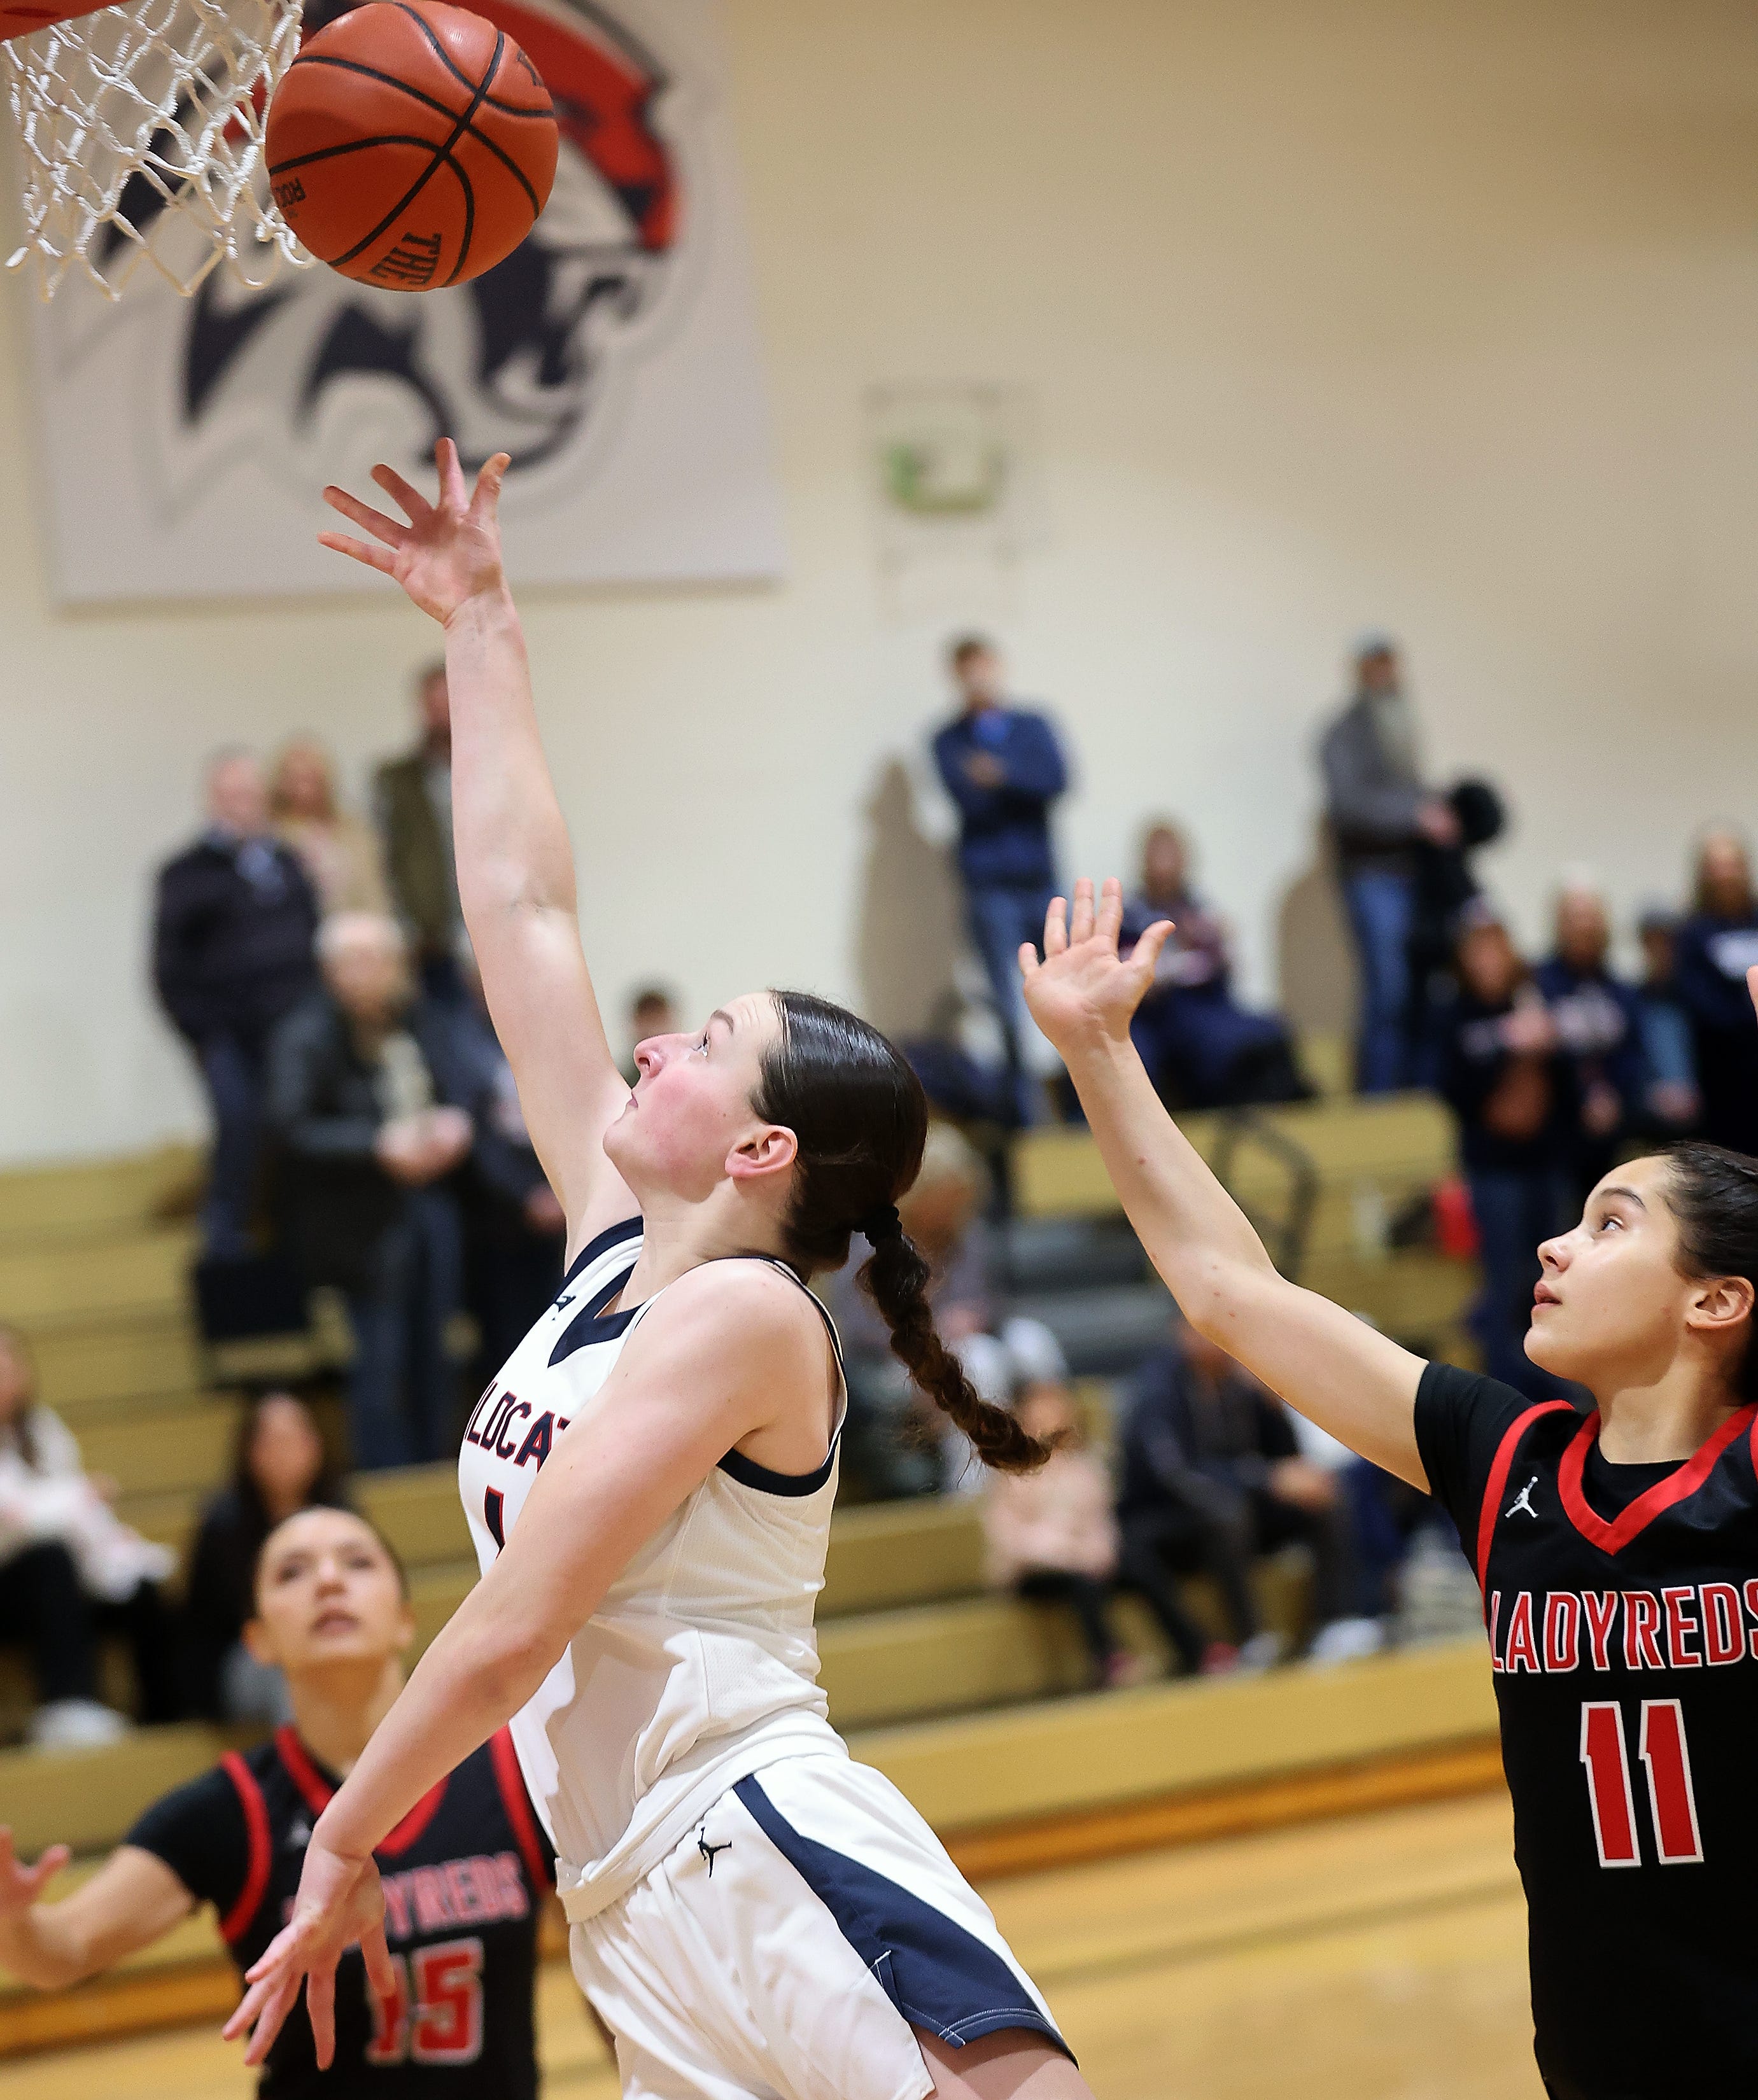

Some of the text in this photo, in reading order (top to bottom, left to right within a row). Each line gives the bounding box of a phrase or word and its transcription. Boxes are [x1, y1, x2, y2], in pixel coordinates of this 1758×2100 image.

[369, 232, 442, 285] THE
[464, 1380, 571, 1474] LDCA
[1579, 1698, 1705, 1868] 11
[366, 1937, 484, 2065] 15
